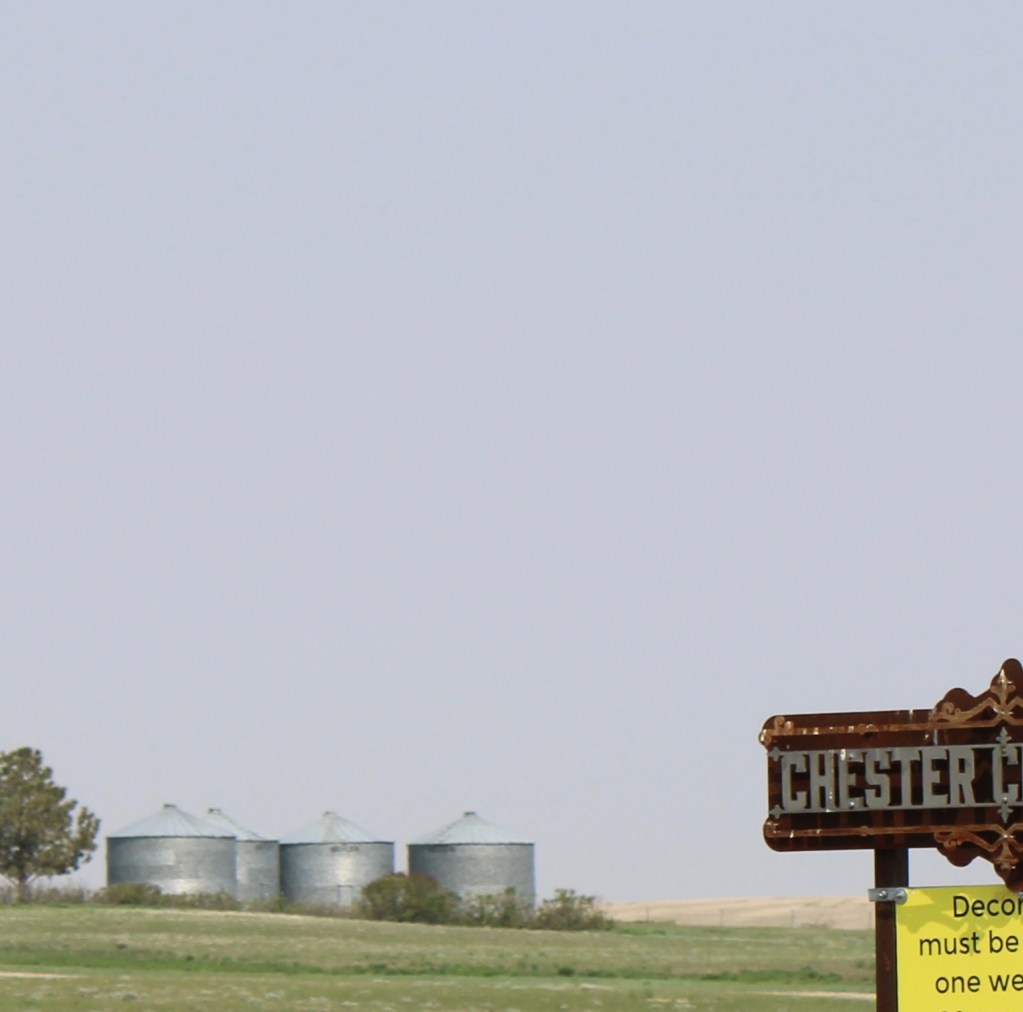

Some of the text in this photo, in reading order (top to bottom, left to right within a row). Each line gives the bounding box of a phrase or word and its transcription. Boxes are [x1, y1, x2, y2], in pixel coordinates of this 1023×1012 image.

[780, 748, 976, 811] CHESTER
[919, 931, 981, 956] must
[989, 930, 1019, 954] be
[935, 975, 981, 994] one
